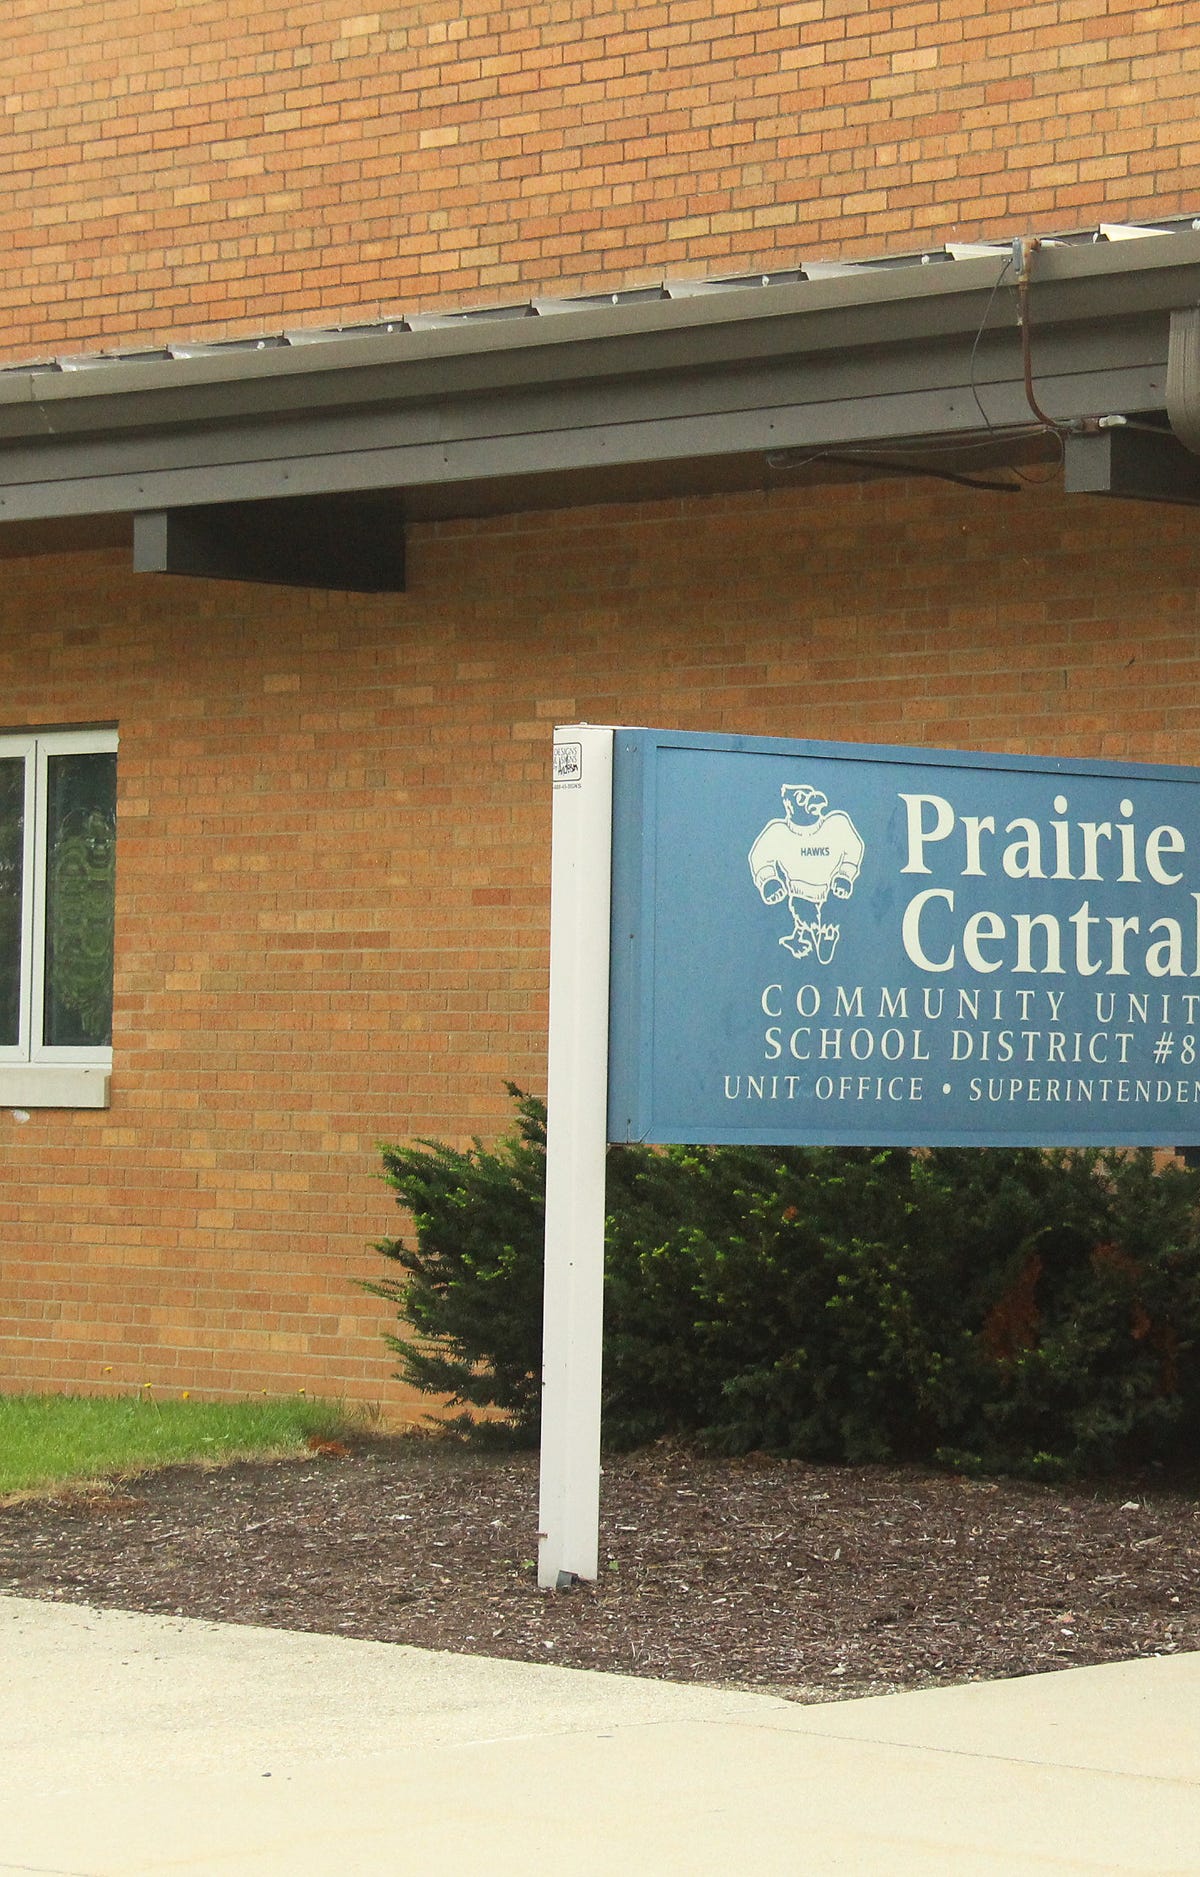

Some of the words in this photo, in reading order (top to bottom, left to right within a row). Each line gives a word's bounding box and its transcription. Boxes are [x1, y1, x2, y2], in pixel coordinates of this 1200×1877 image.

[800, 847, 830, 857] HAWKS
[898, 793, 1186, 886] Prairie
[761, 983, 1065, 1021] COMMUNITY
[1095, 992, 1200, 1025] UNIT
[764, 1026, 930, 1061] SCHOOL
[950, 1030, 1134, 1064] DISTRICT
[1153, 1031, 1196, 1065] #8
[724, 1075, 800, 1100] UNIT
[815, 1076, 923, 1101] OFFICE
